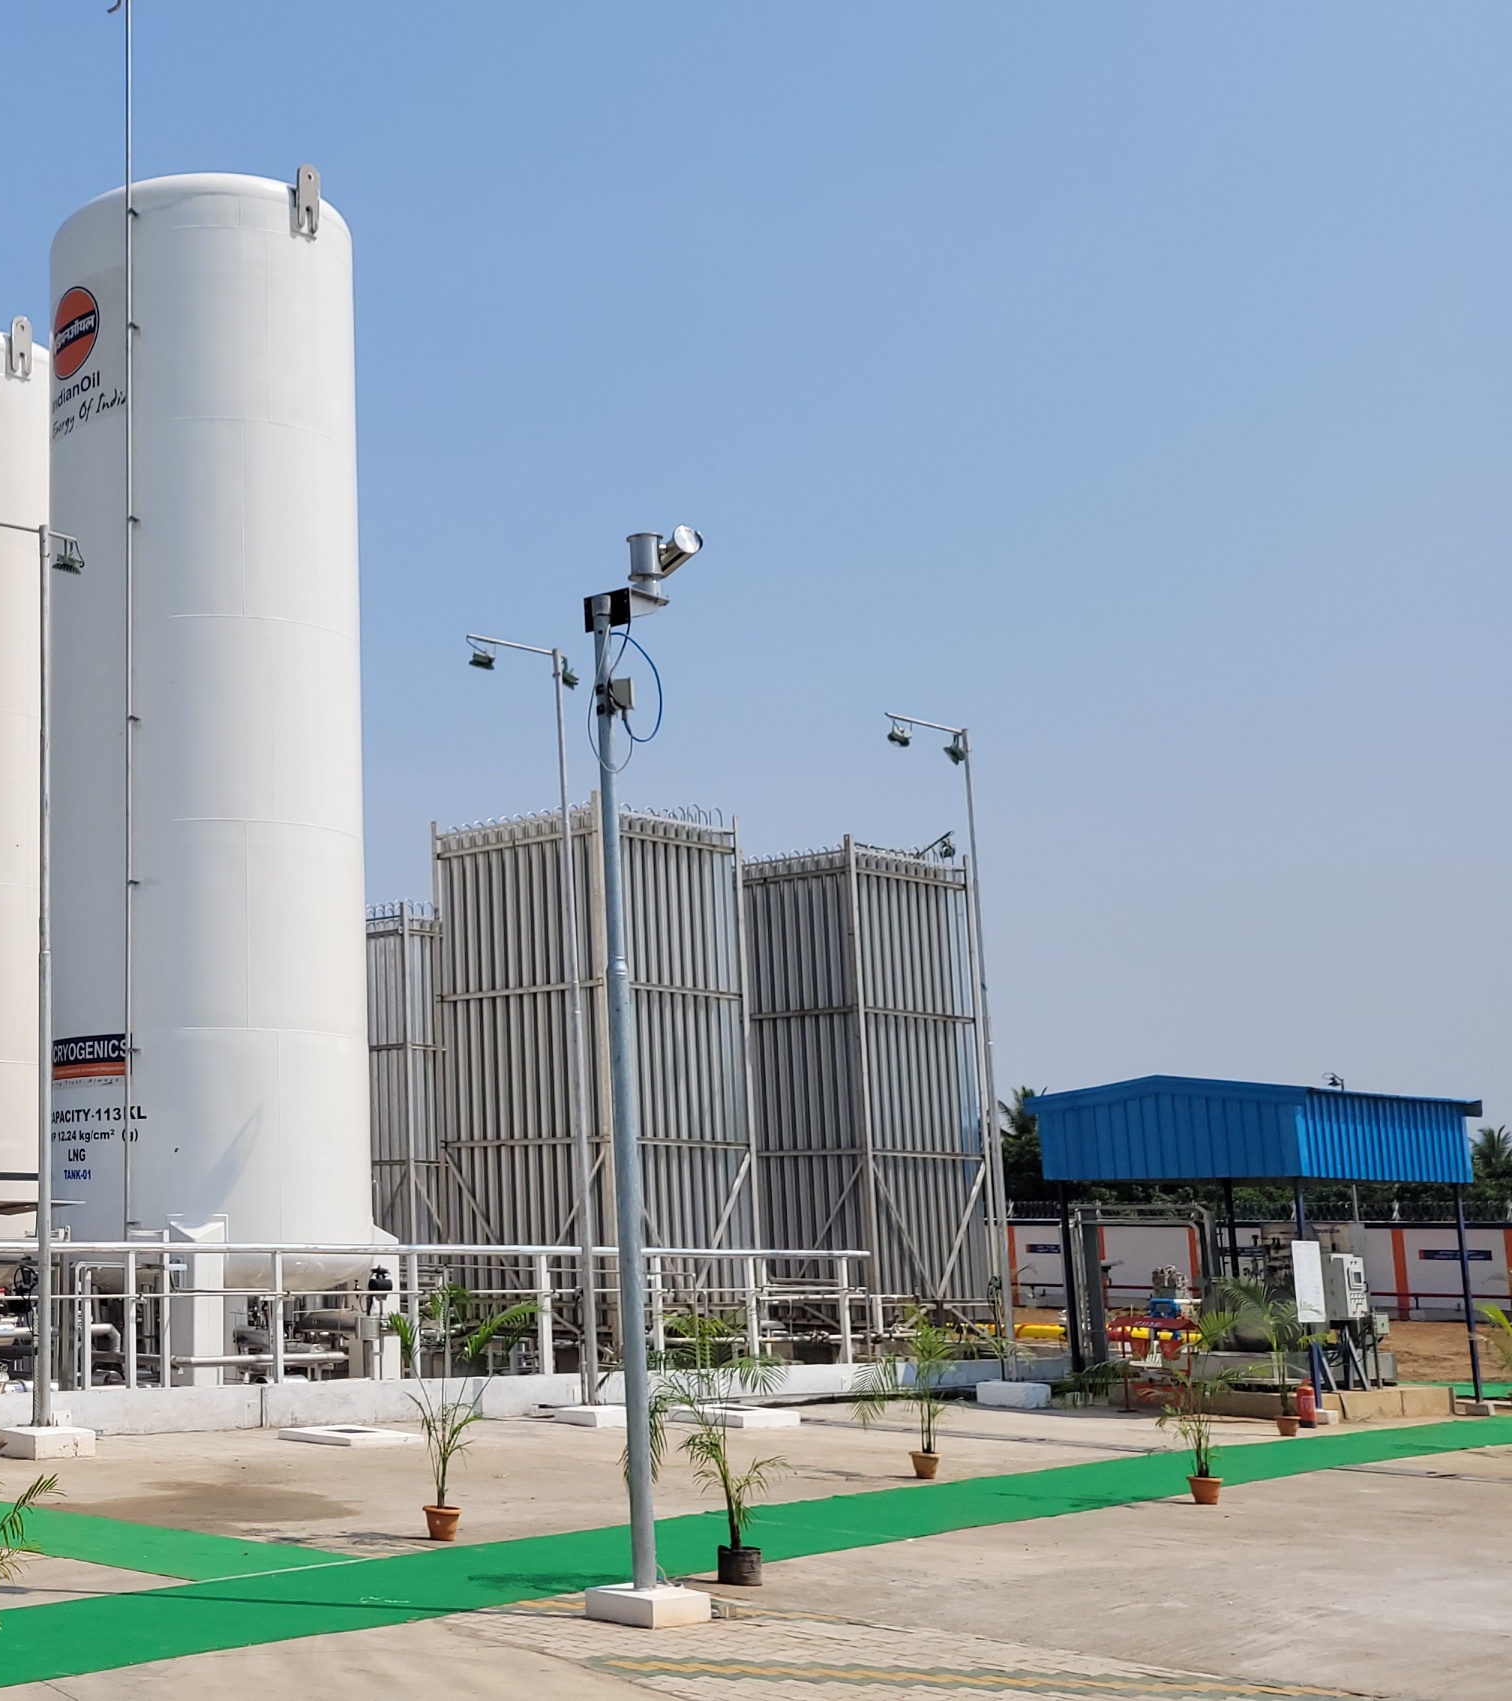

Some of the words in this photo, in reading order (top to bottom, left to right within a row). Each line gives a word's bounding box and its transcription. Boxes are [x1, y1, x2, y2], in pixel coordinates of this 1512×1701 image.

[52, 370, 100, 415] ndianOil
[79, 397, 94, 422] Of
[53, 1039, 127, 1063] CRYOGENICS
[58, 1130, 76, 1142] 12.24
[68, 1148, 86, 1162] LNG
[64, 1169, 91, 1180] TANK-01
